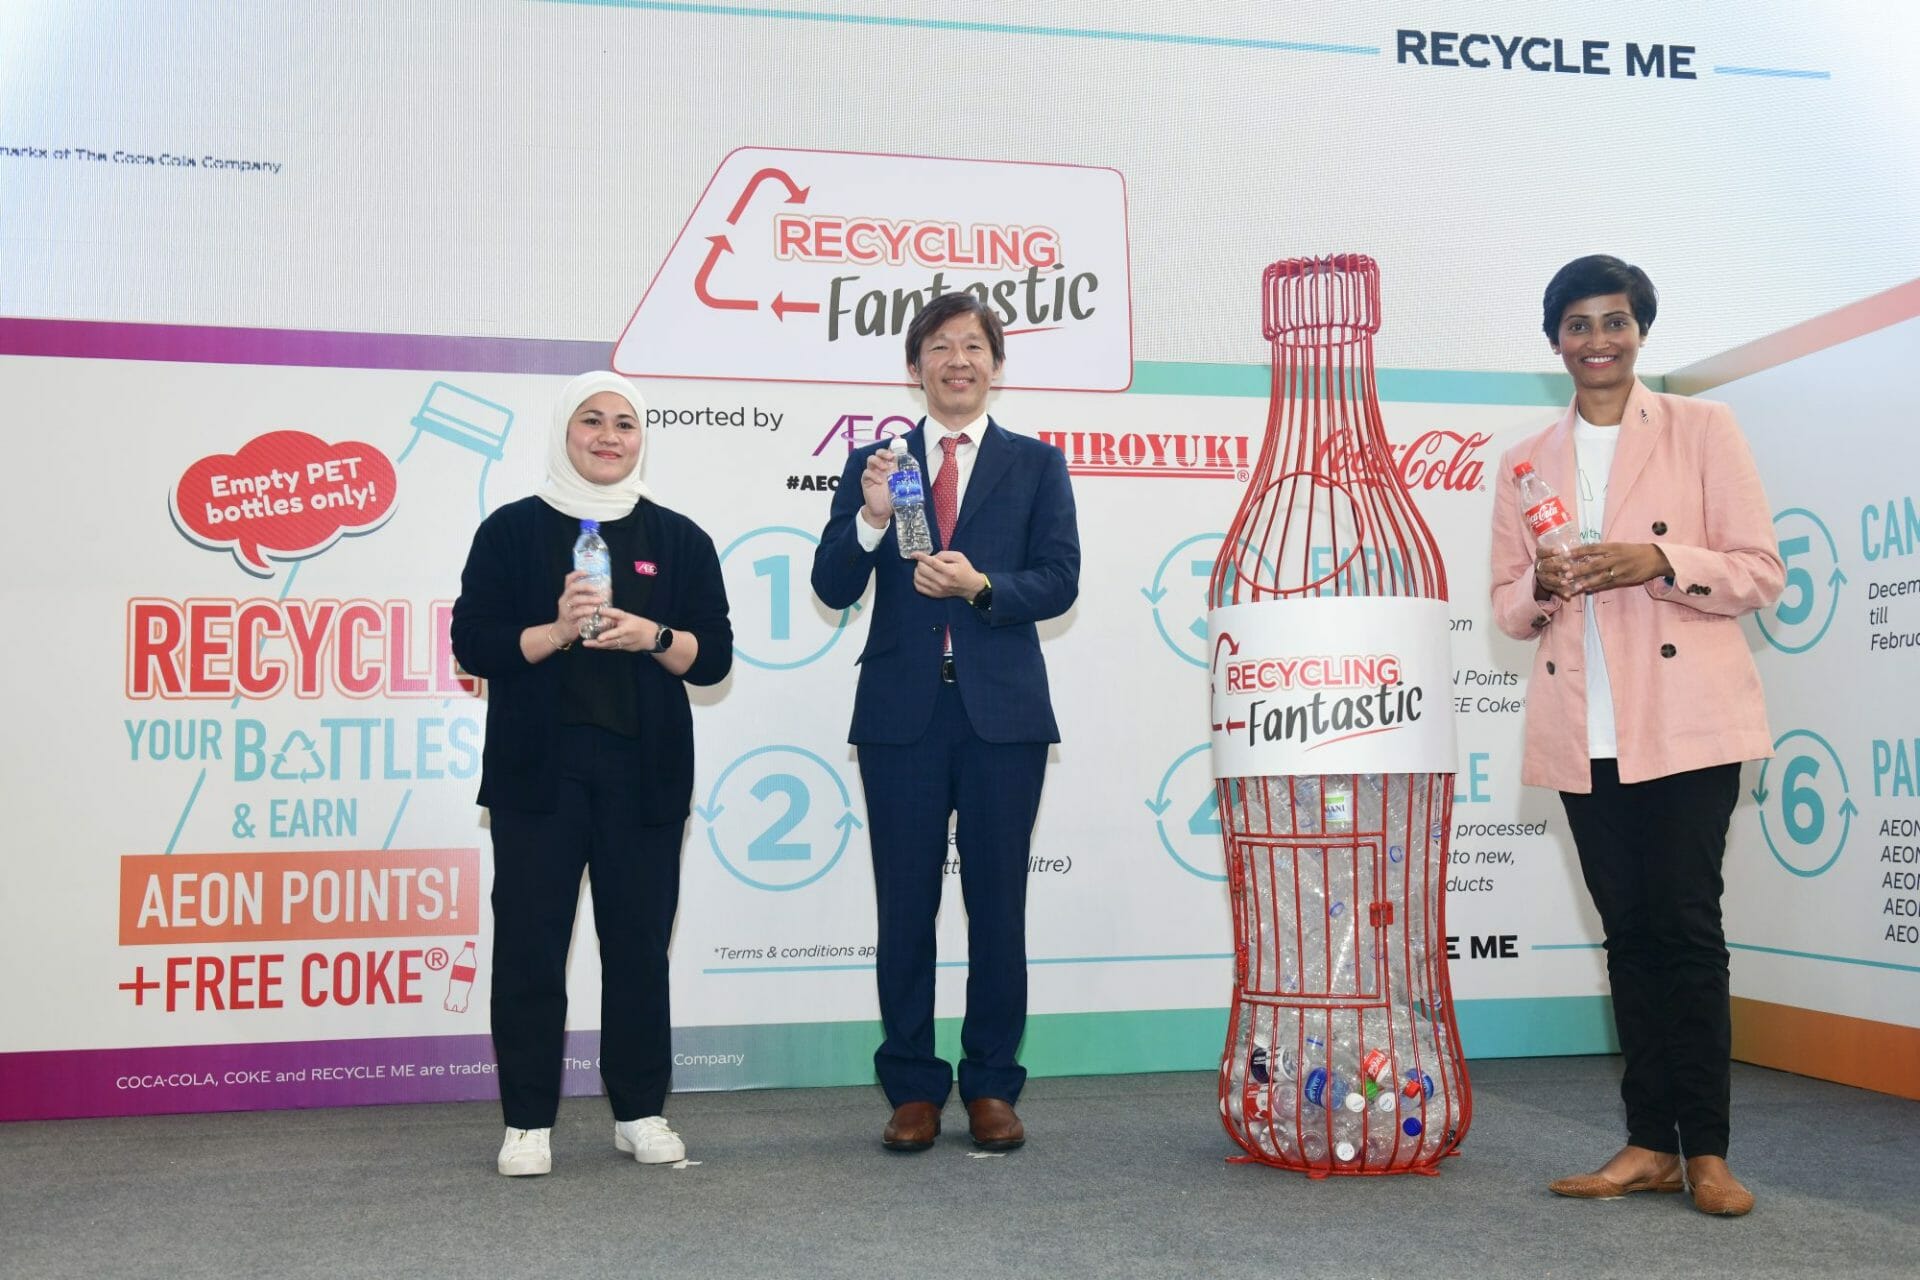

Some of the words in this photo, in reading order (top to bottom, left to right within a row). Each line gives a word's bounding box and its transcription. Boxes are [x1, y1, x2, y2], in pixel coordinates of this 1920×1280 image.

[1397, 29, 1610, 76] RECYCLE
[1626, 42, 1697, 79] ME
[202, 155, 282, 174] Company
[779, 218, 1057, 268] RECYCLING
[753, 407, 784, 431] by
[211, 468, 299, 498] Empty
[306, 457, 362, 485] PET
[205, 494, 304, 525] bottles
[310, 481, 377, 511] only!
[753, 555, 790, 640] 1
[1775, 535, 1814, 625] 5
[1869, 606, 1889, 625] till
[130, 601, 478, 696] RECYCLE
[1227, 657, 1400, 692] RECYCLING
[1464, 670, 1519, 686] Points
[1249, 681, 1423, 748] Fantastic
[124, 718, 222, 761] YOUR
[231, 802, 256, 839] &
[269, 797, 358, 839] EARN
[748, 773, 811, 861] 2
[1782, 755, 1825, 845] 6
[1456, 820, 1547, 840] processed
[1475, 851, 1516, 866] new,
[137, 871, 263, 929] AEON
[281, 867, 460, 925] POINTS!
[1883, 897, 1920, 917] AEO
[766, 946, 778, 958] &
[780, 944, 854, 959] conditions
[857, 945, 878, 959] ap
[1470, 935, 1519, 959] ME
[116, 1072, 219, 1090] COCA-COLA,
[224, 1070, 271, 1085] COKE
[275, 1068, 306, 1083] and
[311, 1065, 386, 1081] RECYCLE
[390, 1064, 416, 1078] ME
[419, 1065, 445, 1077] are
[562, 1057, 591, 1070] The
[673, 1052, 745, 1067] Company
